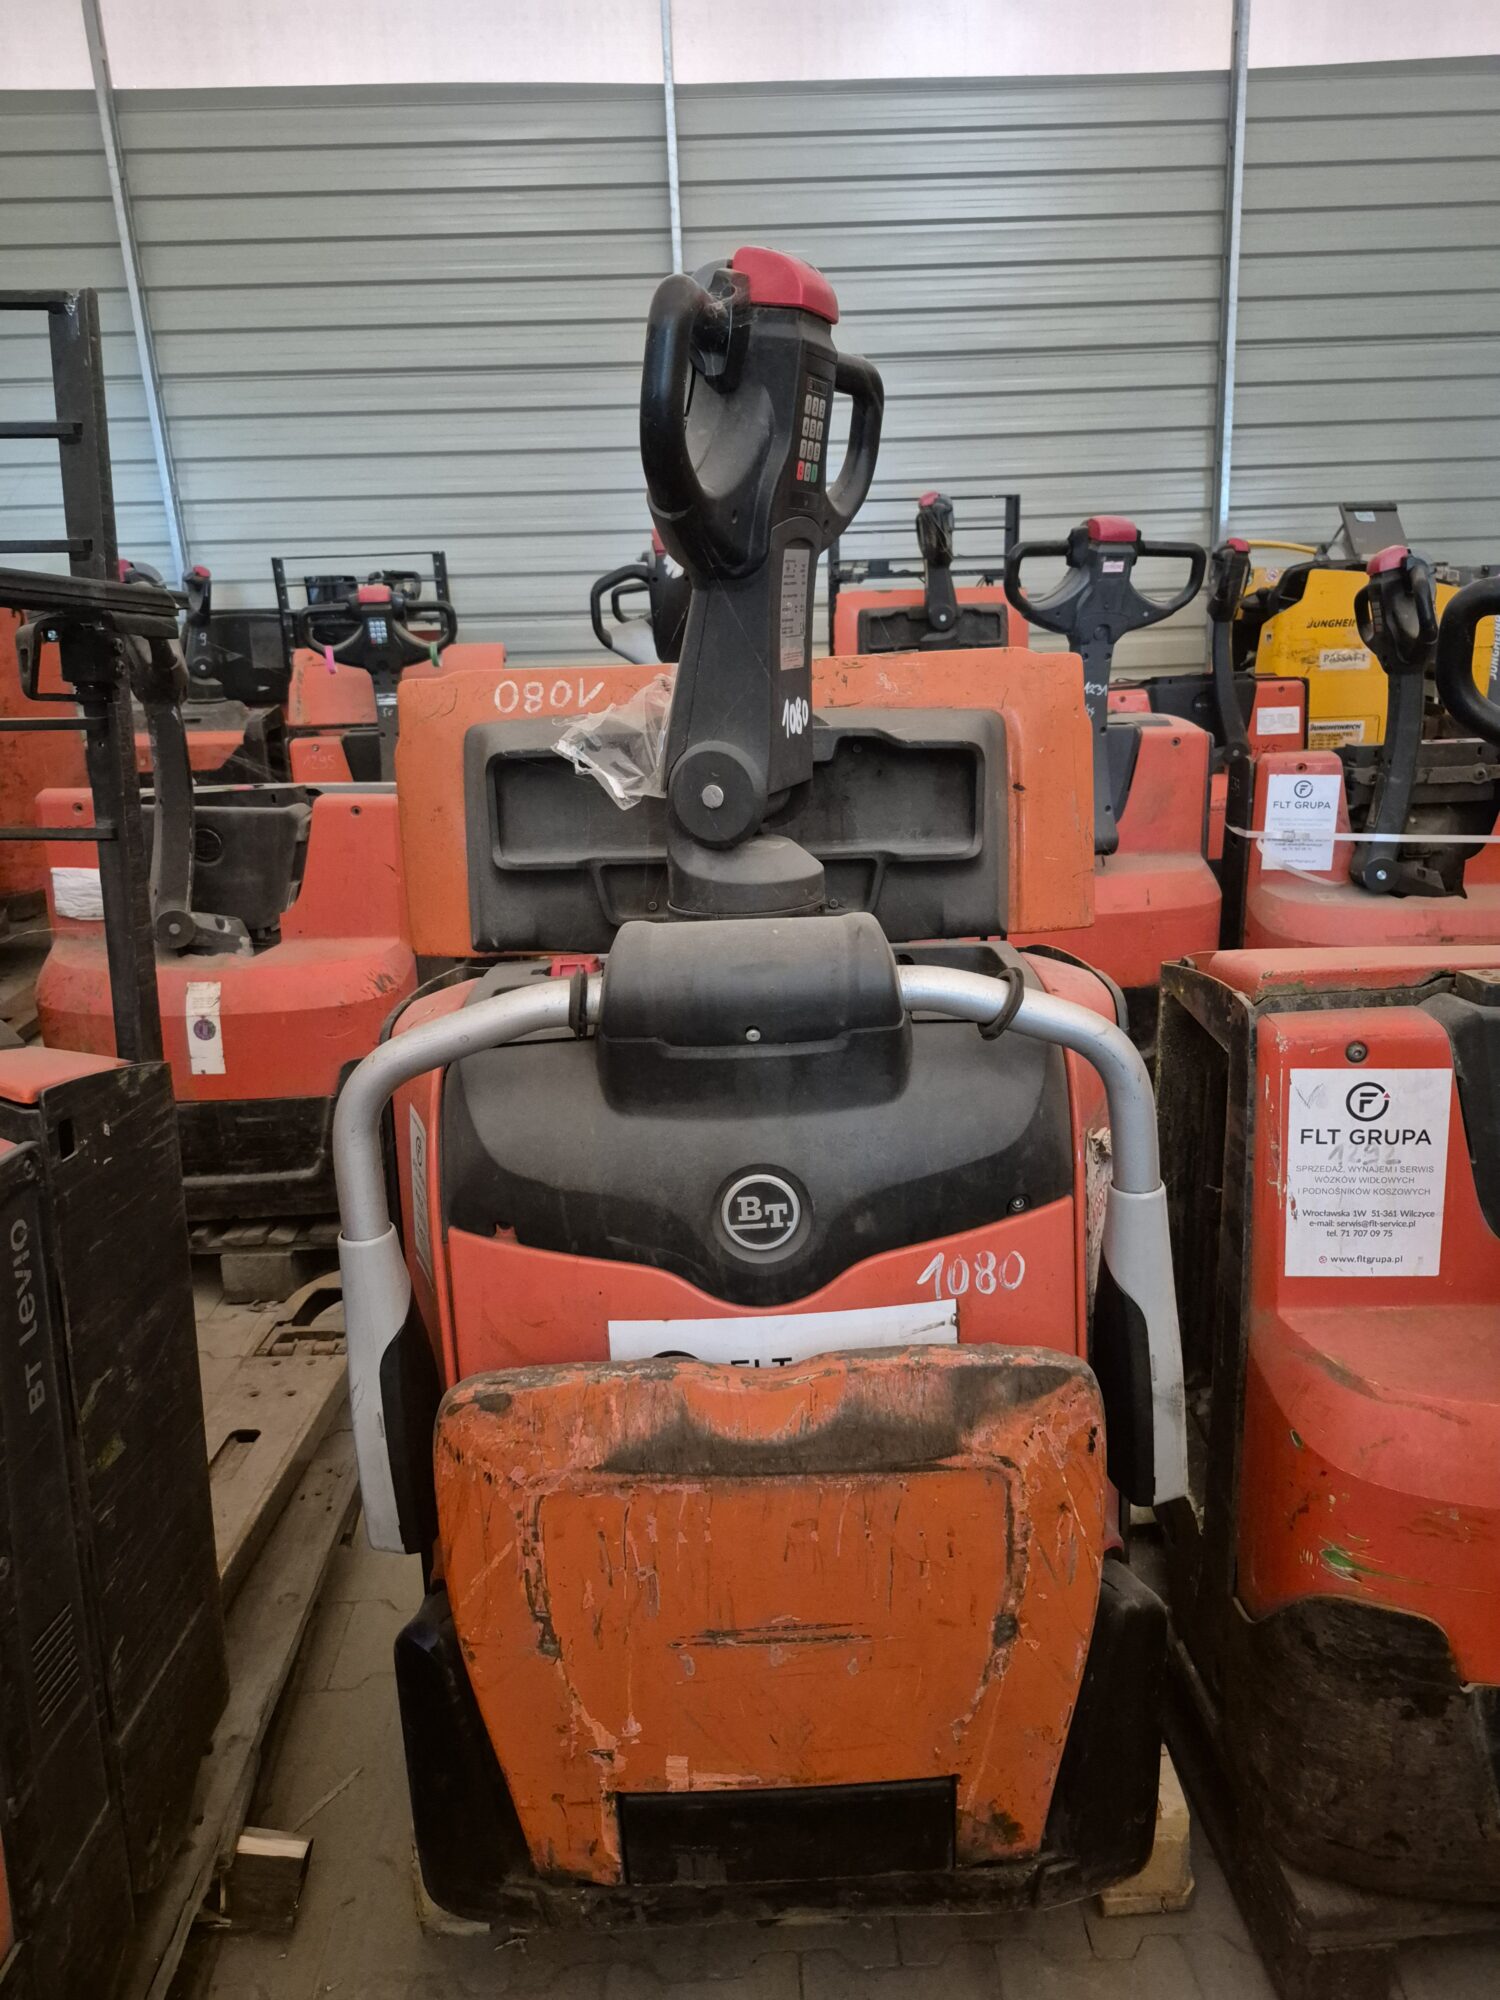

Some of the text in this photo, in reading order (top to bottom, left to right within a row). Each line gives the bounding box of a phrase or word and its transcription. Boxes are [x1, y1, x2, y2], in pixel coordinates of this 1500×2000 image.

[782, 696, 809, 739] 1080
[1273, 800, 1331, 809] FLT GRUPA
[1300, 1128, 1432, 1146] FLT GRUPA
[1348, 1165, 1393, 1173] WYNAJEM
[1399, 1165, 1434, 1173] SERWIS
[1314, 1175, 1415, 1184] WÓZKÓW WIDŁOWYCH
[1302, 1186, 1370, 1195] PODNOŚNIKÓW
[1373, 1188, 1431, 1196] KOSZOWYCH
[737, 1196, 788, 1228] BT
[1302, 1209, 1351, 1217] Wrocławska
[1400, 1209, 1435, 1218] Wilczyce
[1326, 1229, 1337, 1237] tel.
[1369, 1230, 1381, 1238] 09
[1383, 1230, 1393, 1238] 75
[916, 1250, 1026, 1300] 1080
[25, 1361, 46, 1415] BT
